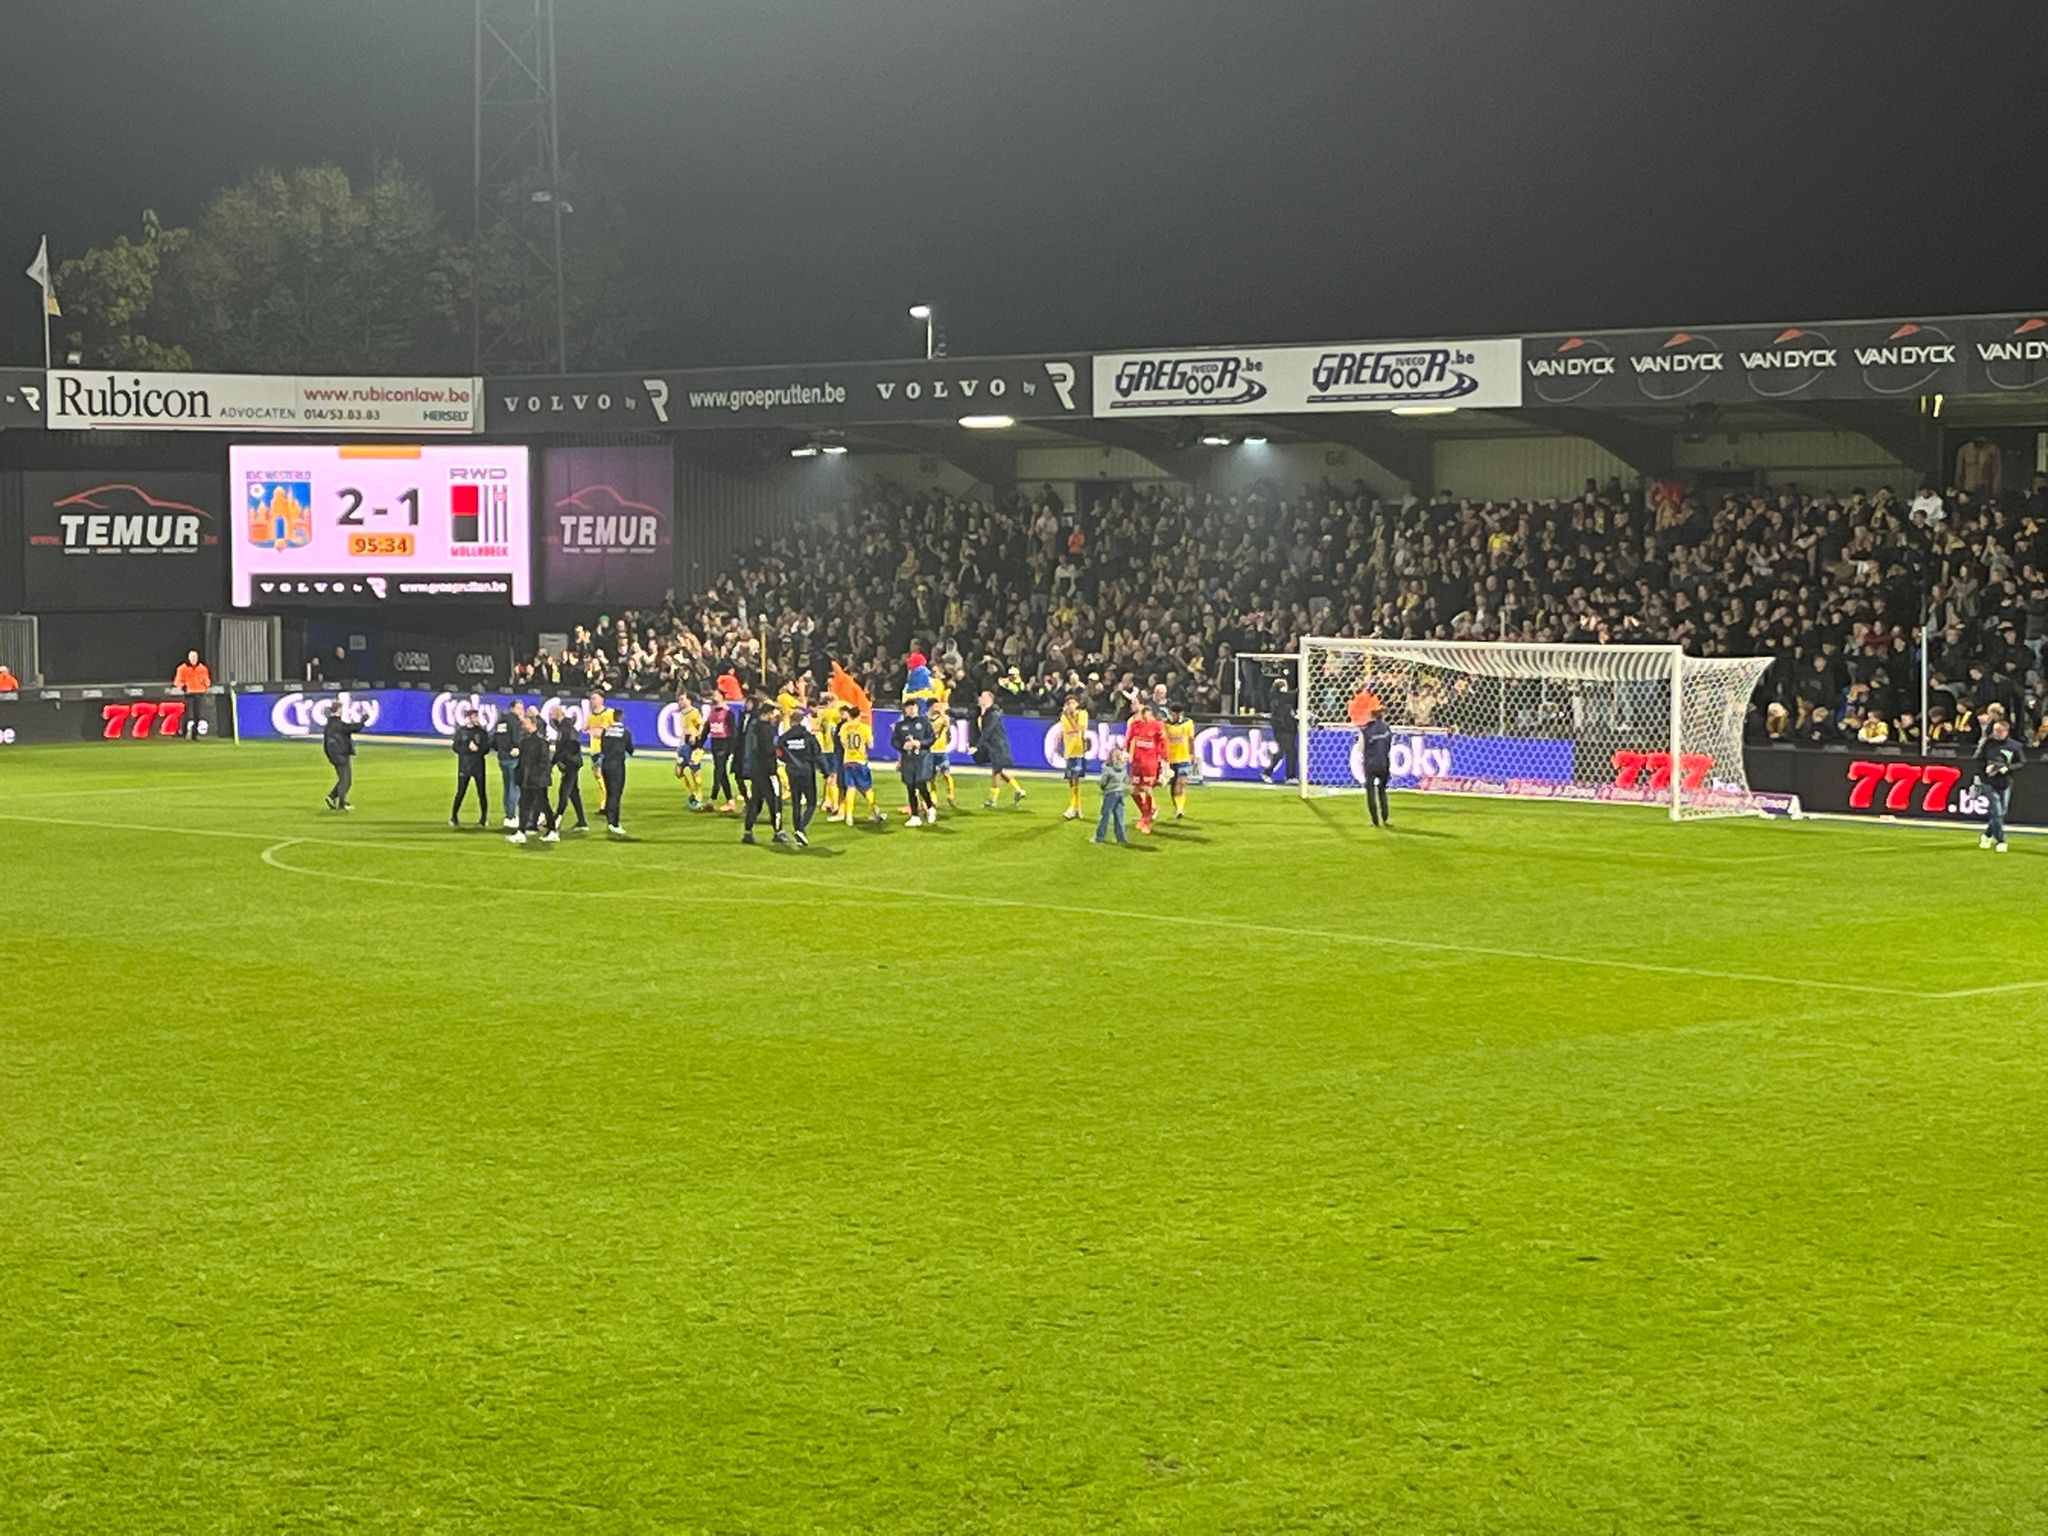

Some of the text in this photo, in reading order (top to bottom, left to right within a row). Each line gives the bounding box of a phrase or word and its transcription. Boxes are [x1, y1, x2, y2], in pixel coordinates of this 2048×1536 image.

[55, 376, 296, 419] Rubicon ADVOCATEN
[304, 386, 470, 404] www.rubiconlaw.be
[690, 383, 846, 411] www.groeprutten.be
[876, 379, 1006, 400] VOLVO
[504, 394, 611, 413] VOLVO
[450, 468, 507, 479] RWD
[355, 538, 408, 553] 95:34
[846, 733, 862, 750] 10
[1194, 727, 1280, 777] Crok
